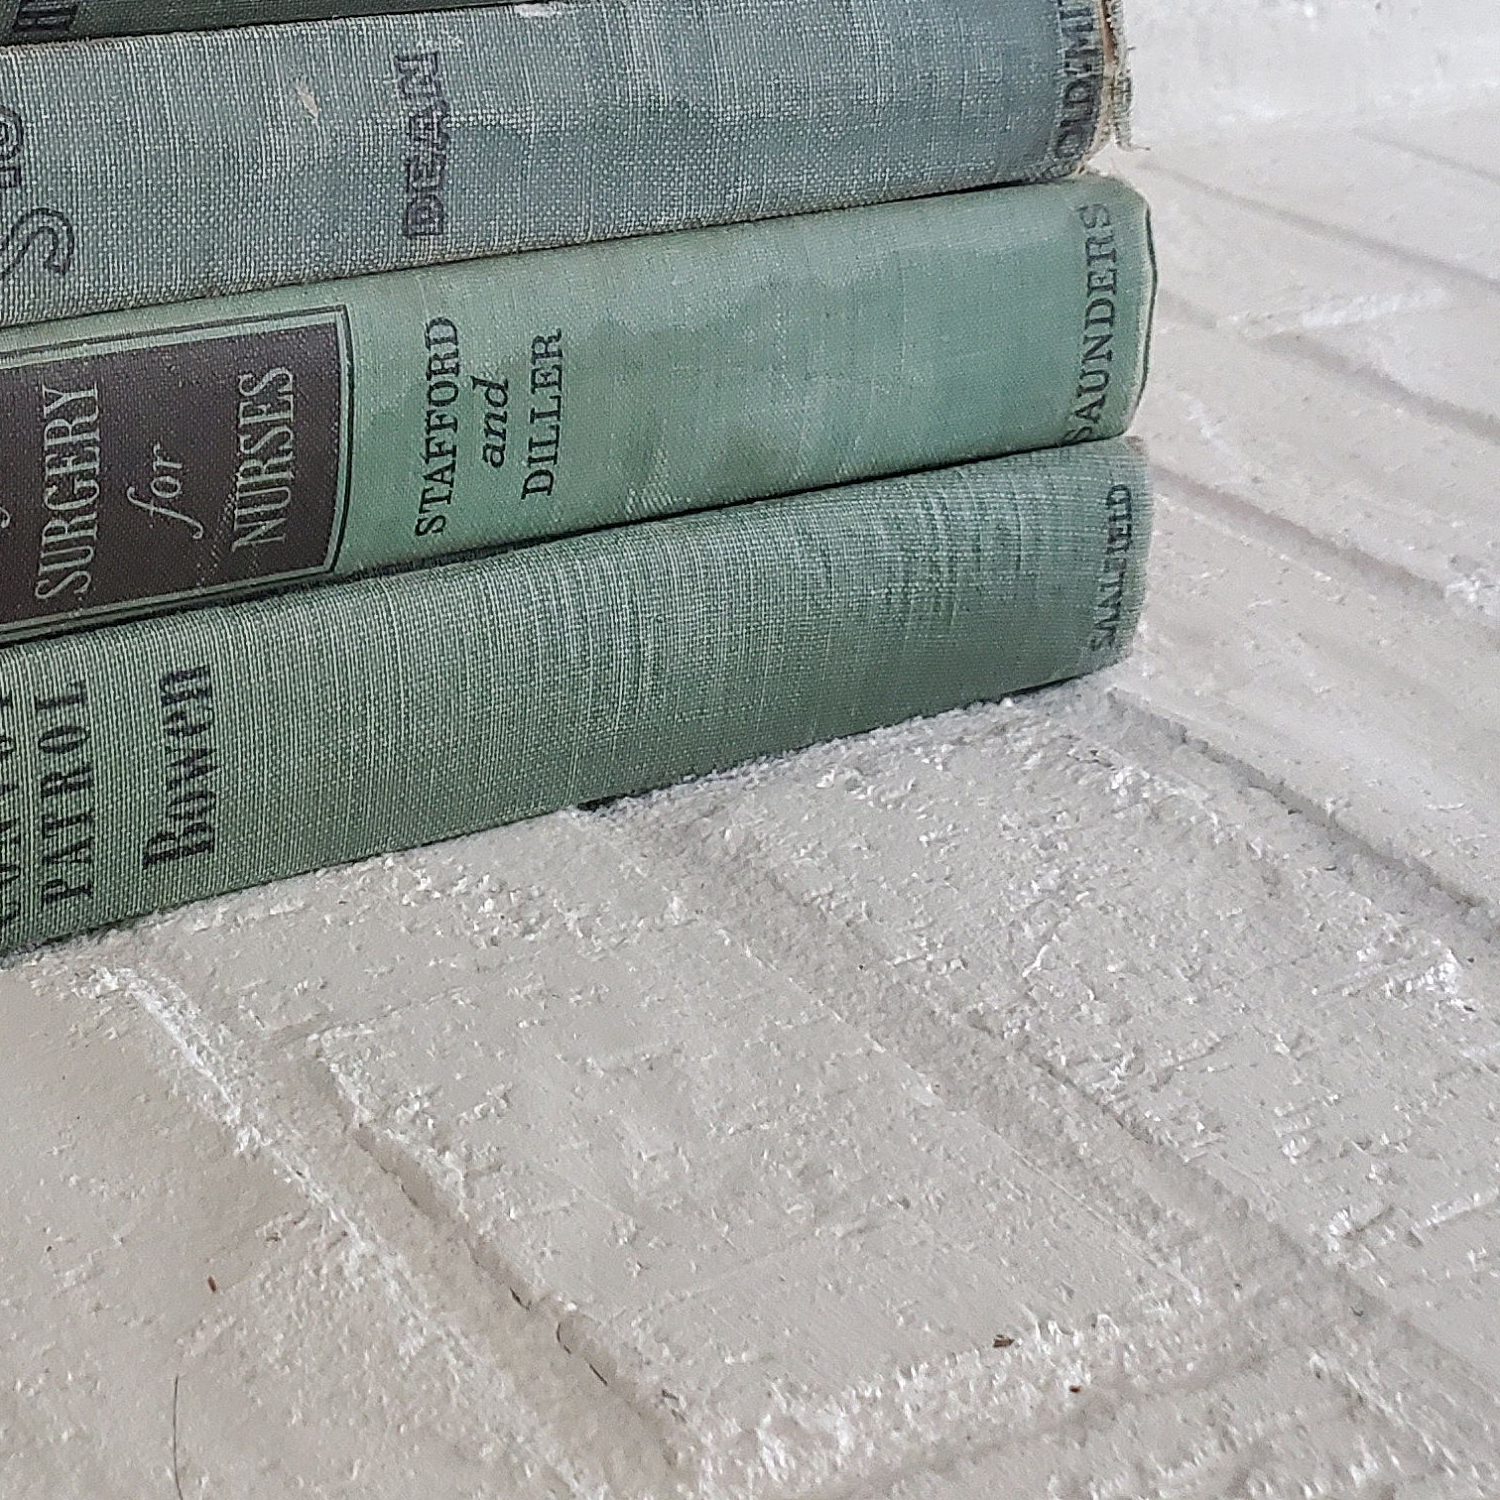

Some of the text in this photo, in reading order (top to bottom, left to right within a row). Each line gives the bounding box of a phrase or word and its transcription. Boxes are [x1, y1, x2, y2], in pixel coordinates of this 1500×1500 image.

[470, 374, 510, 470] and
[521, 327, 565, 501] DILLER
[1062, 201, 1118, 444] SAUNDERS
[34, 382, 101, 601] SURGERY
[126, 442, 205, 541] for
[231, 366, 295, 554] NURSES
[414, 315, 461, 538] STAFFORD
[34, 679, 96, 903] PATROL
[143, 664, 219, 870] Bowen
